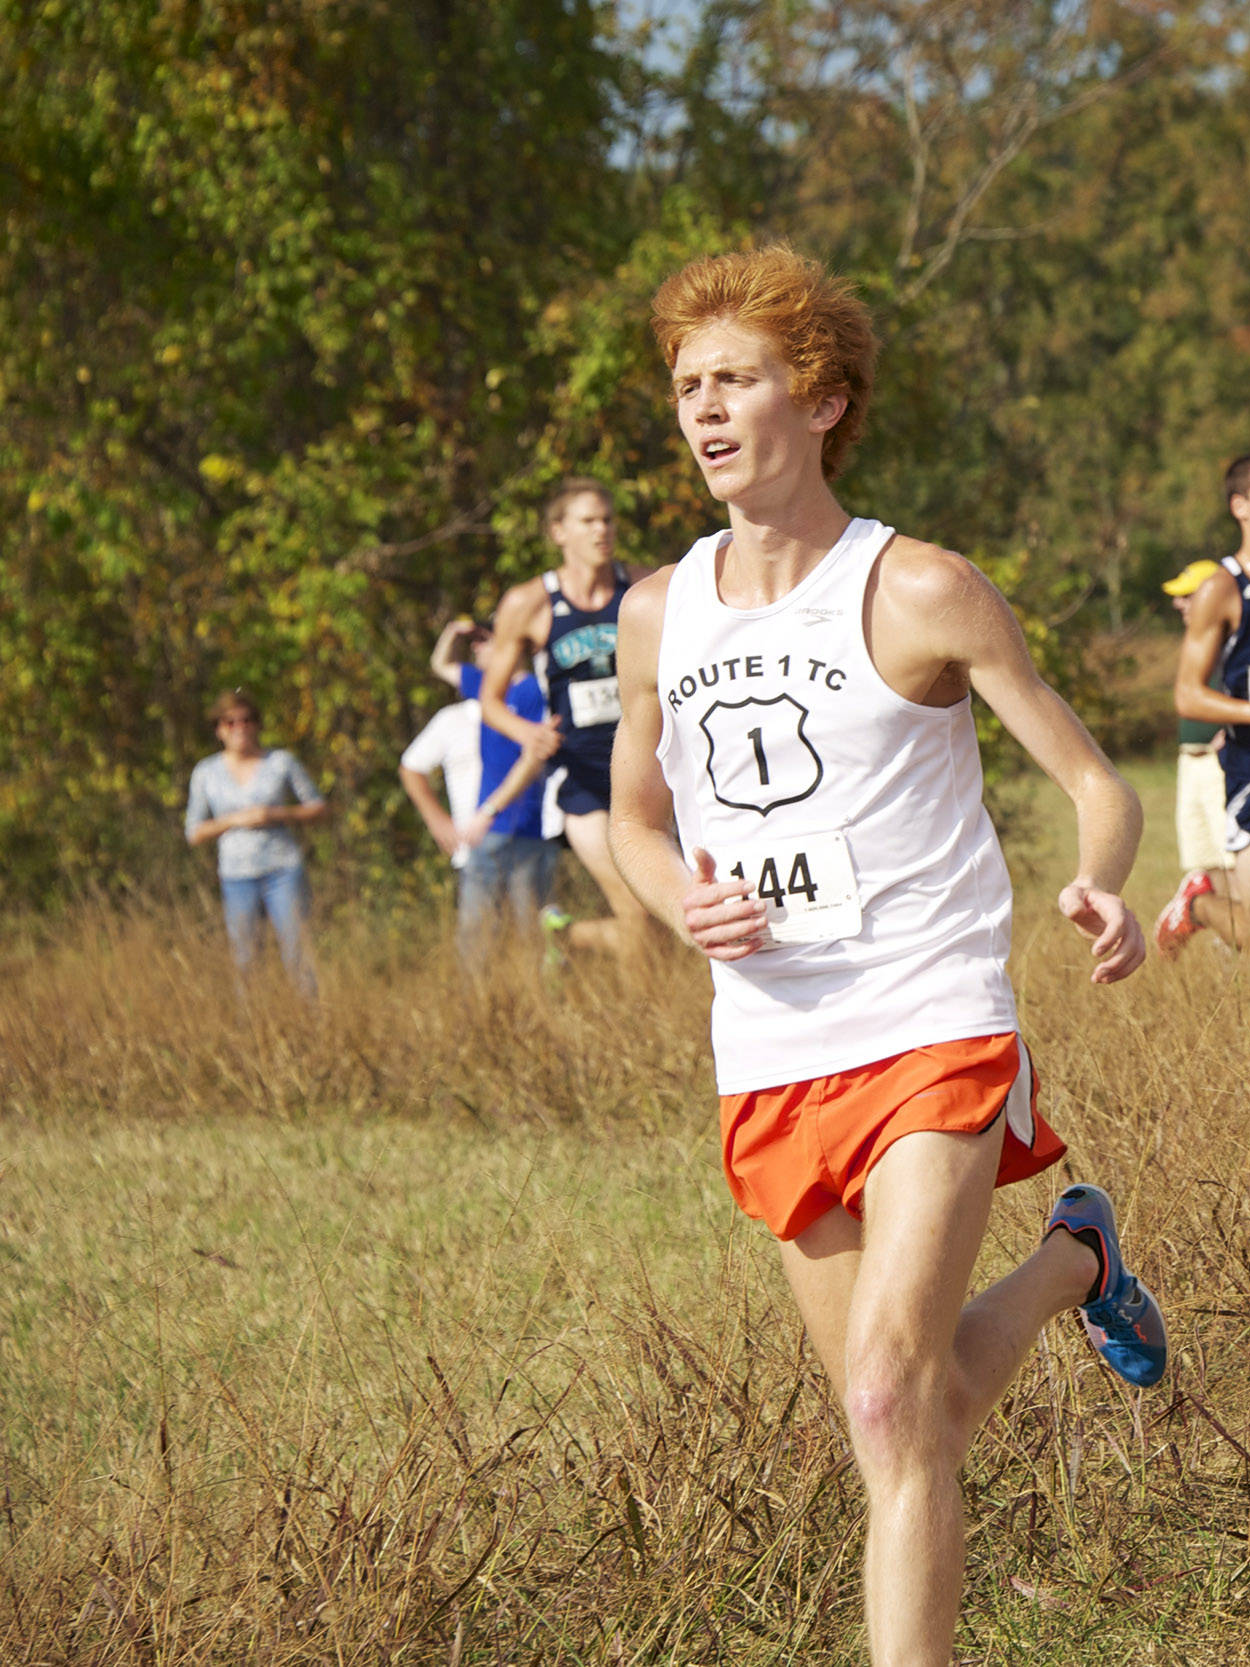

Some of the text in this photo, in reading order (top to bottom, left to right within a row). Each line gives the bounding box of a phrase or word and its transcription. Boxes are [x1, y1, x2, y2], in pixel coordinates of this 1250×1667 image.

[667, 654, 848, 714] ROUTE 1 TC
[746, 726, 770, 786] 1
[730, 852, 819, 908] 144
